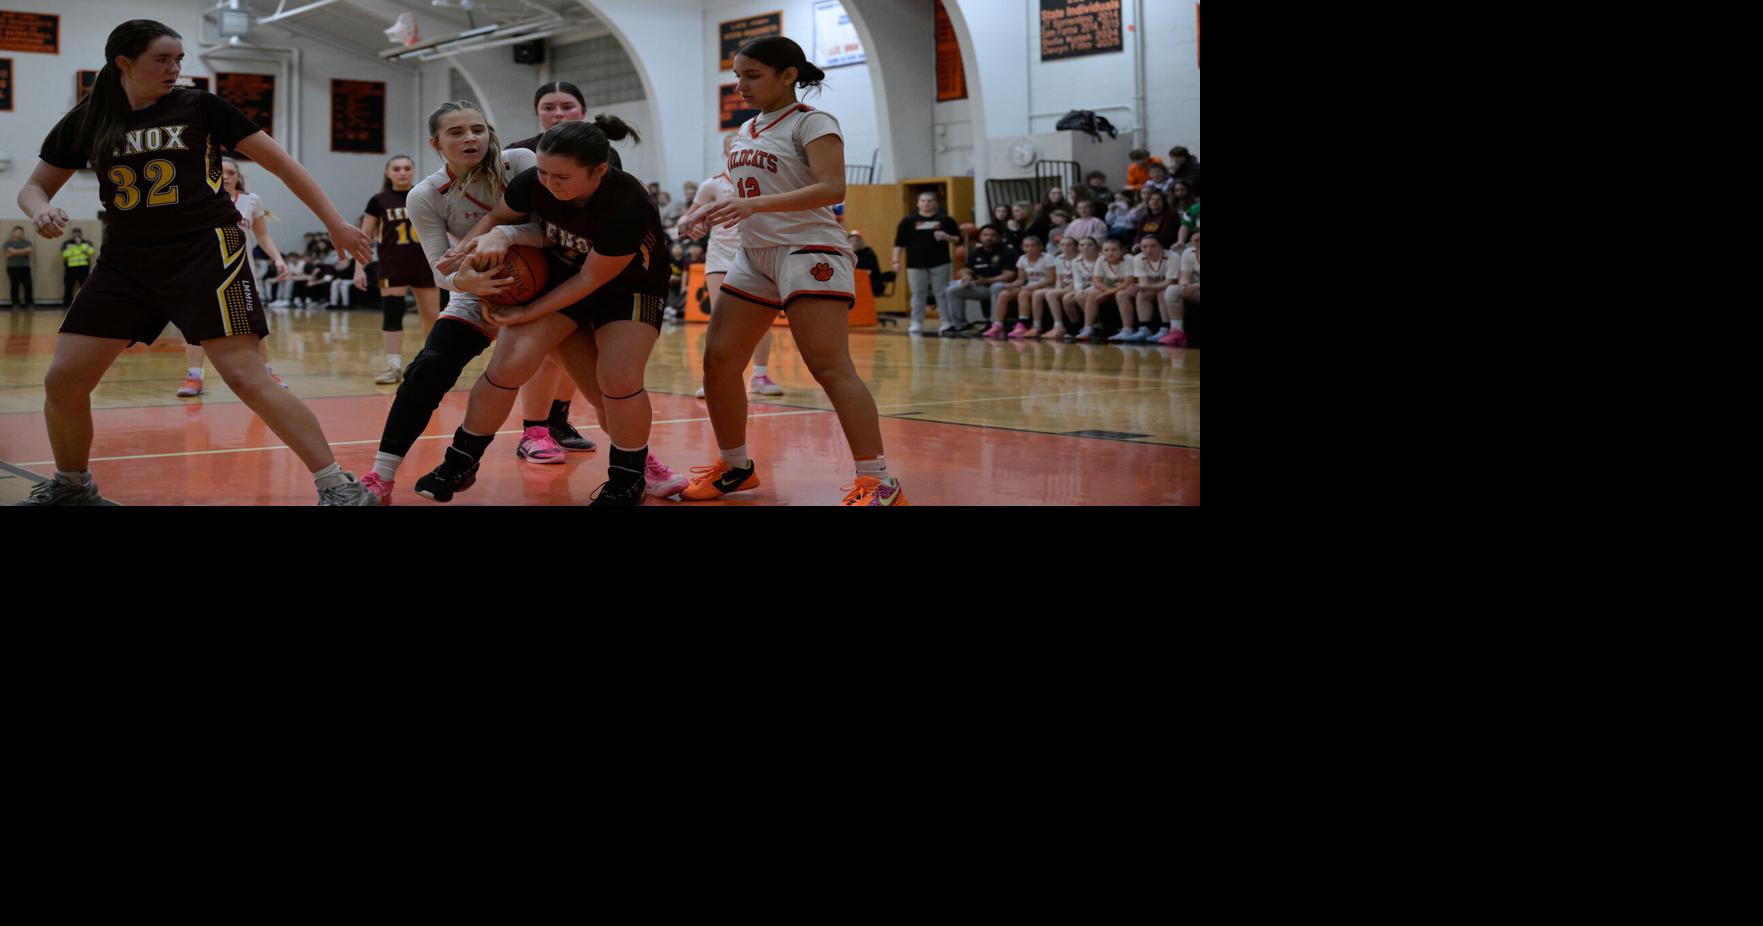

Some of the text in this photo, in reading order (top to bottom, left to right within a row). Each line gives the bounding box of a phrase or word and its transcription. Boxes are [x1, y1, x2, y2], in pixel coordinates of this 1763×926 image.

[1041, 9, 1063, 19] State
[113, 125, 190, 158] NOX
[108, 159, 180, 211] 32
[737, 177, 761, 198] 12
[242, 280, 254, 312] LMMHS
